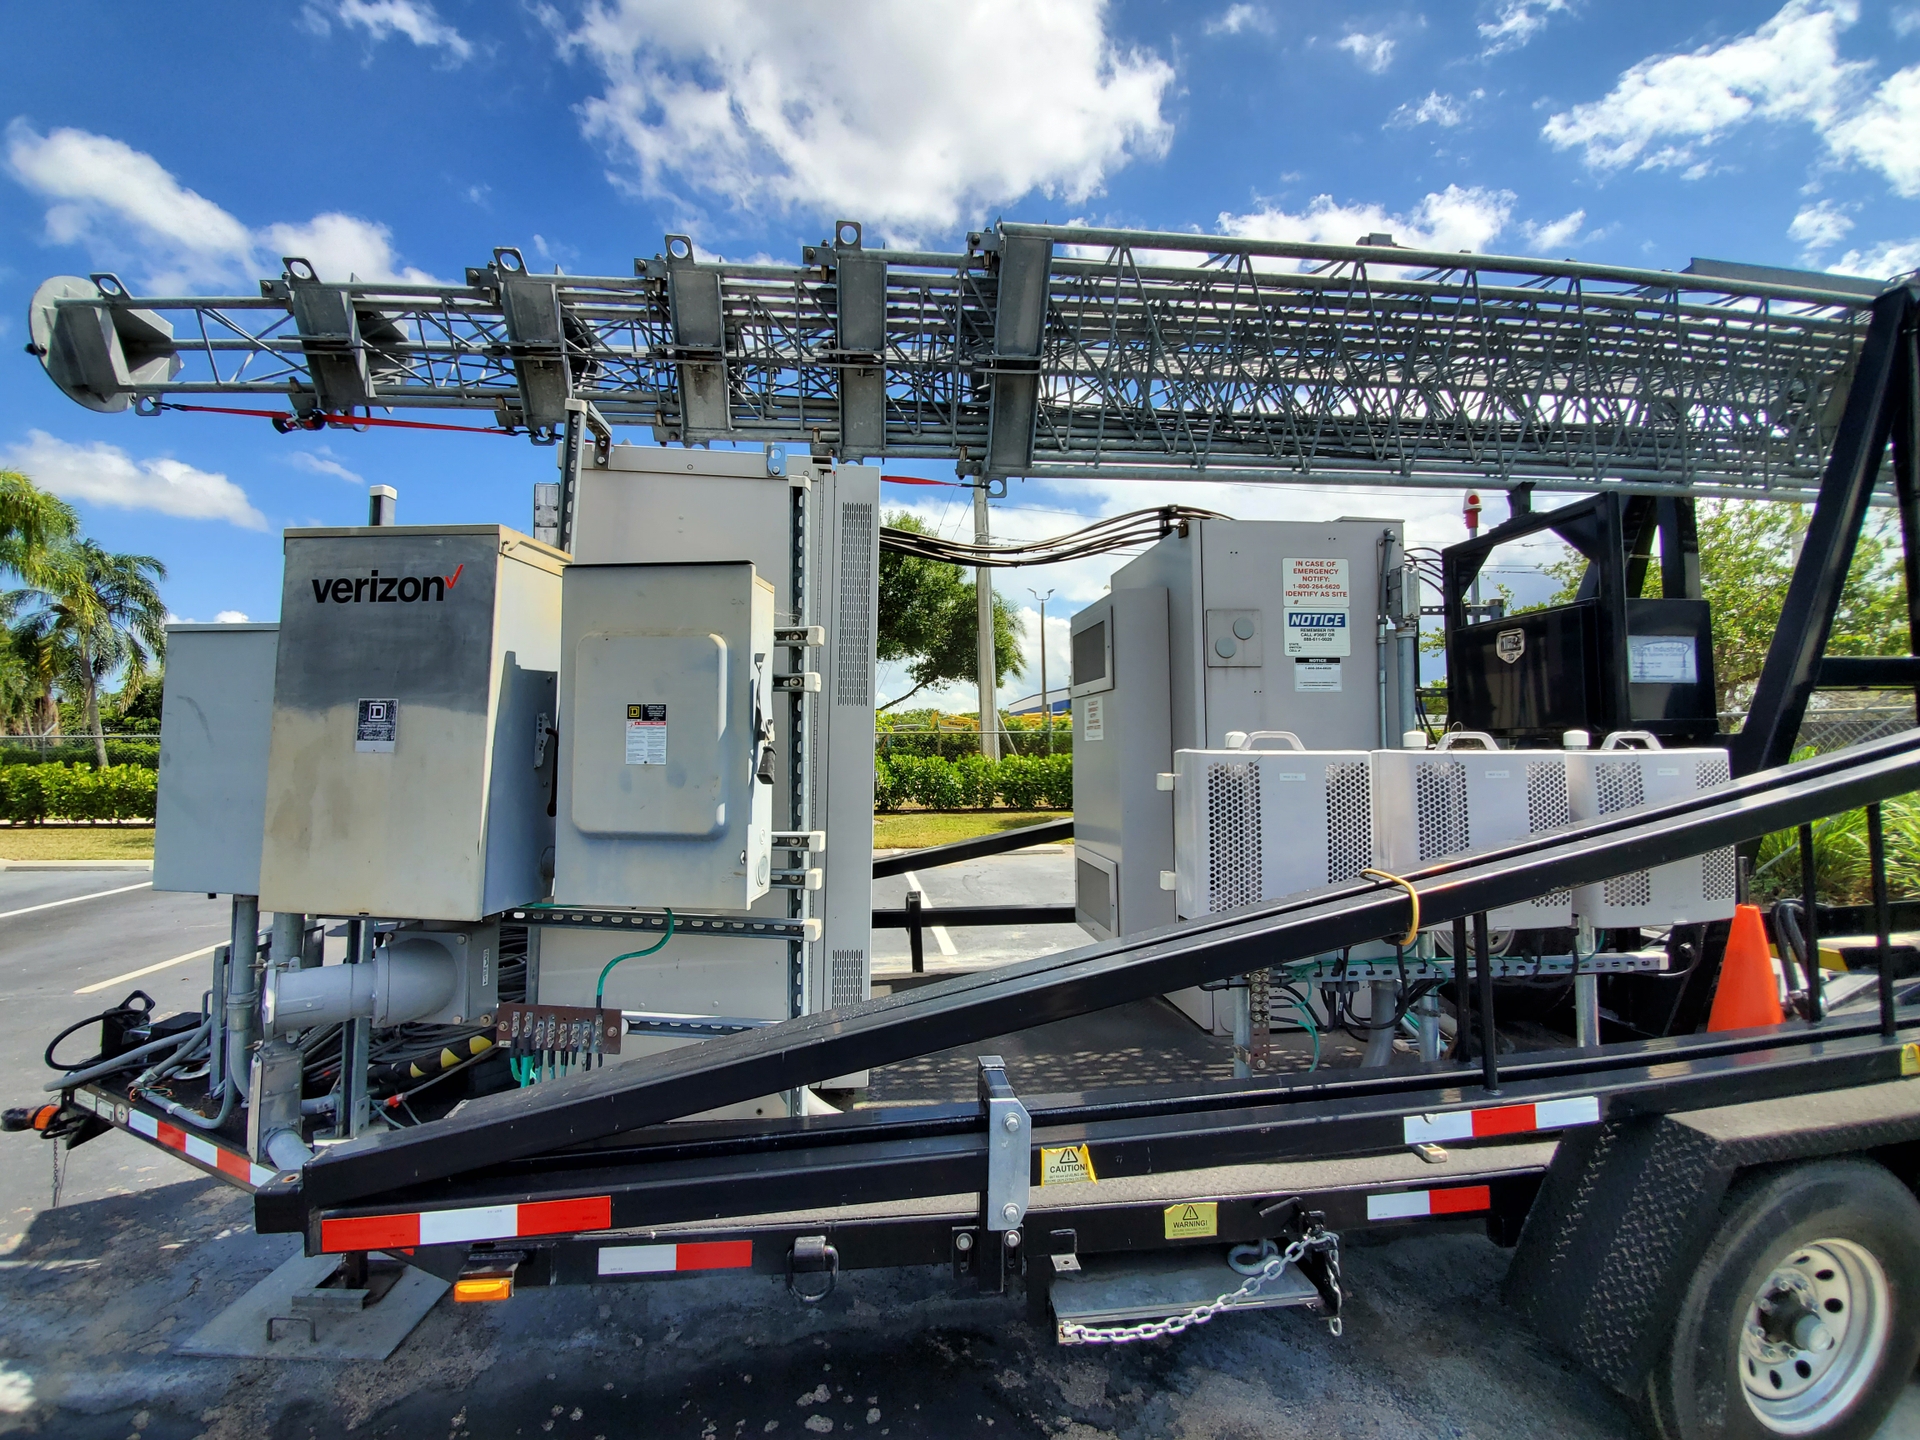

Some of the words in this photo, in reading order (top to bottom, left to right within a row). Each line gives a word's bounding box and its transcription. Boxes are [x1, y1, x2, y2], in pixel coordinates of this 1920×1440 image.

[312, 569, 445, 604] verizon
[1290, 614, 1344, 626] NOTICE
[1050, 1164, 1088, 1173] CAUTION!
[1173, 1220, 1208, 1228] WARNING!
